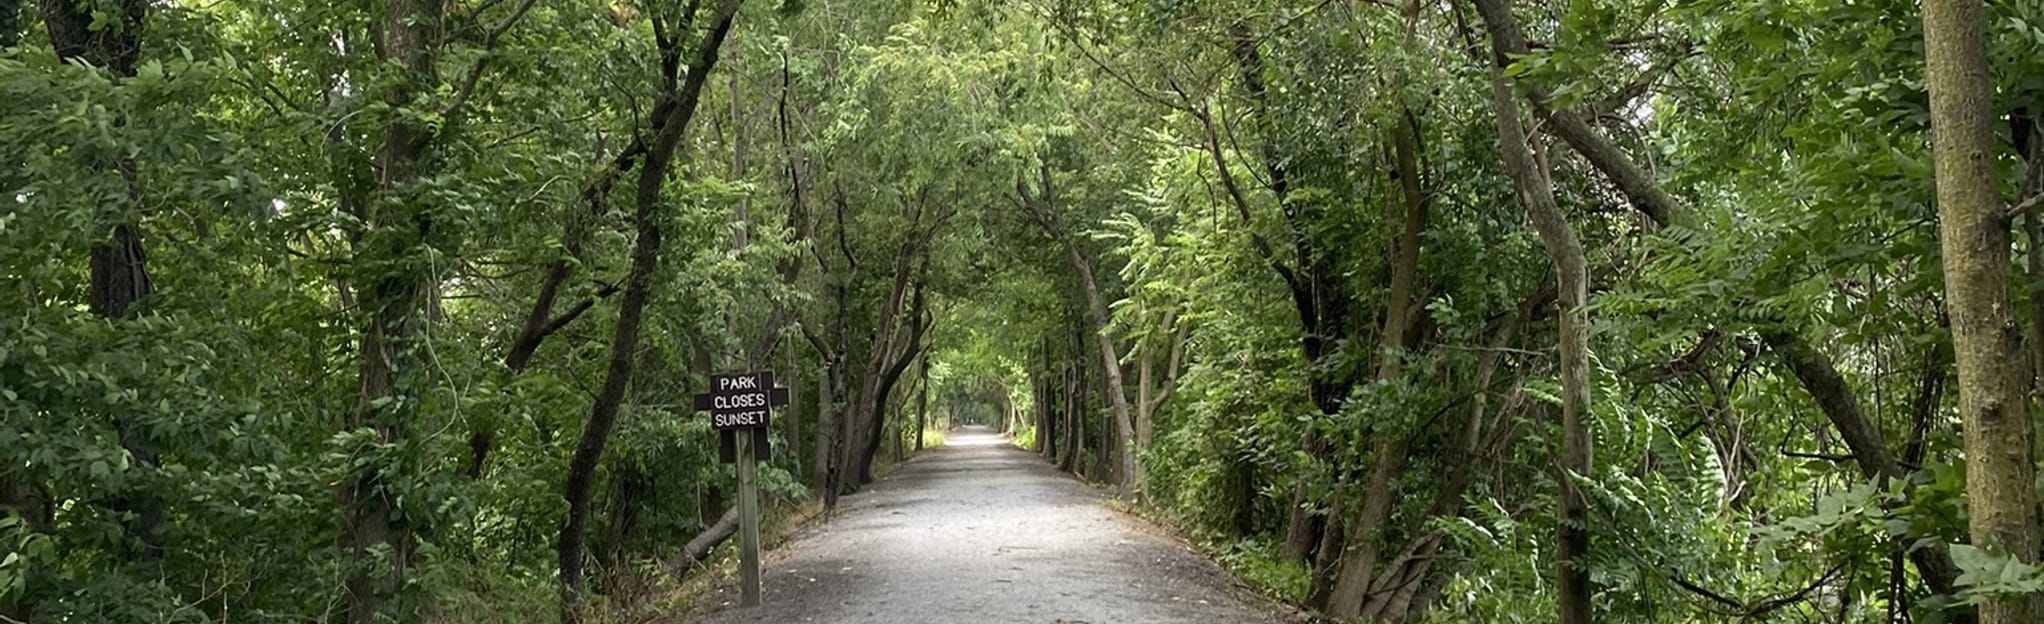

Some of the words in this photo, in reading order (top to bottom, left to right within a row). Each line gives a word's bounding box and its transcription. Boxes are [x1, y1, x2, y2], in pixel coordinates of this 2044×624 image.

[720, 376, 757, 390] PARK
[713, 393, 765, 409] CLOSES
[714, 410, 766, 427] SUNSET
